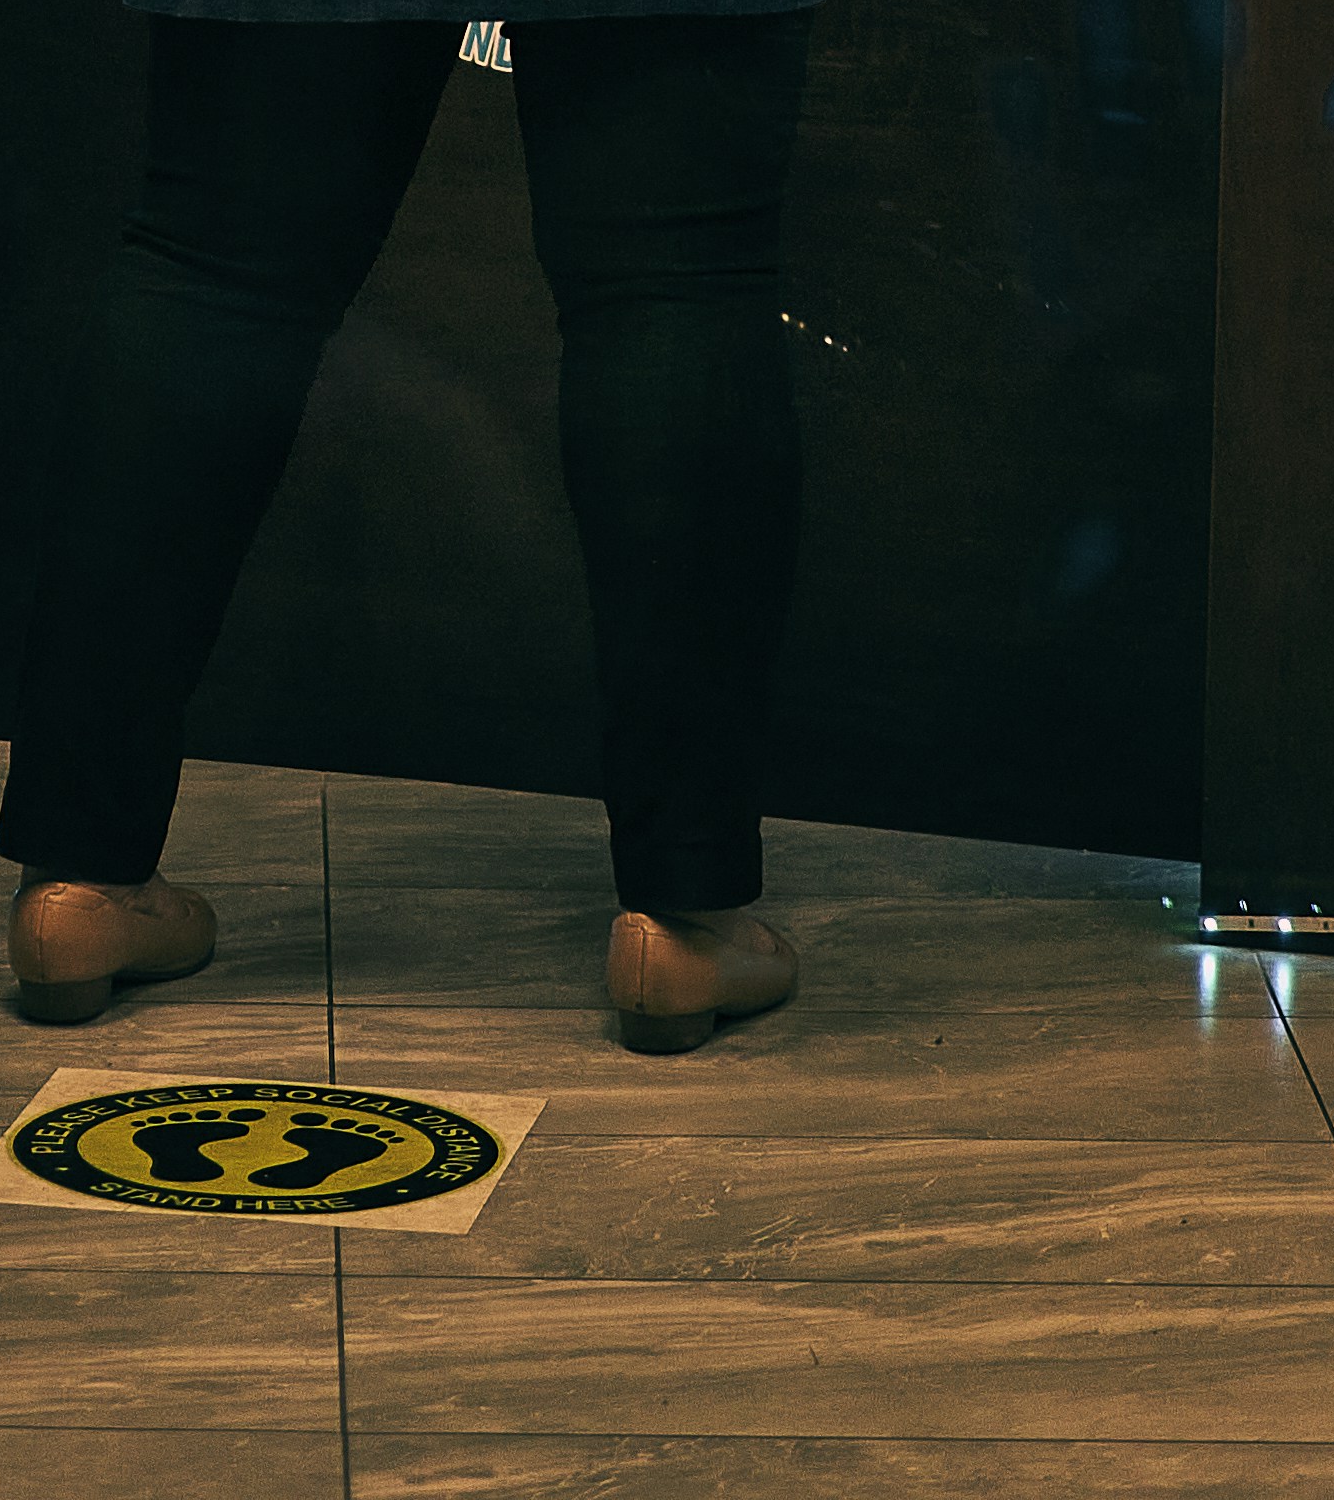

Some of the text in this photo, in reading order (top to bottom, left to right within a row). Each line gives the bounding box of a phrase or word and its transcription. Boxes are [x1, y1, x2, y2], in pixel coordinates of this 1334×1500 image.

[30, 1087, 482, 1182] PLEASE KEEP SOCIAL DISTANCE
[89, 1181, 356, 1211] STAND HERE
